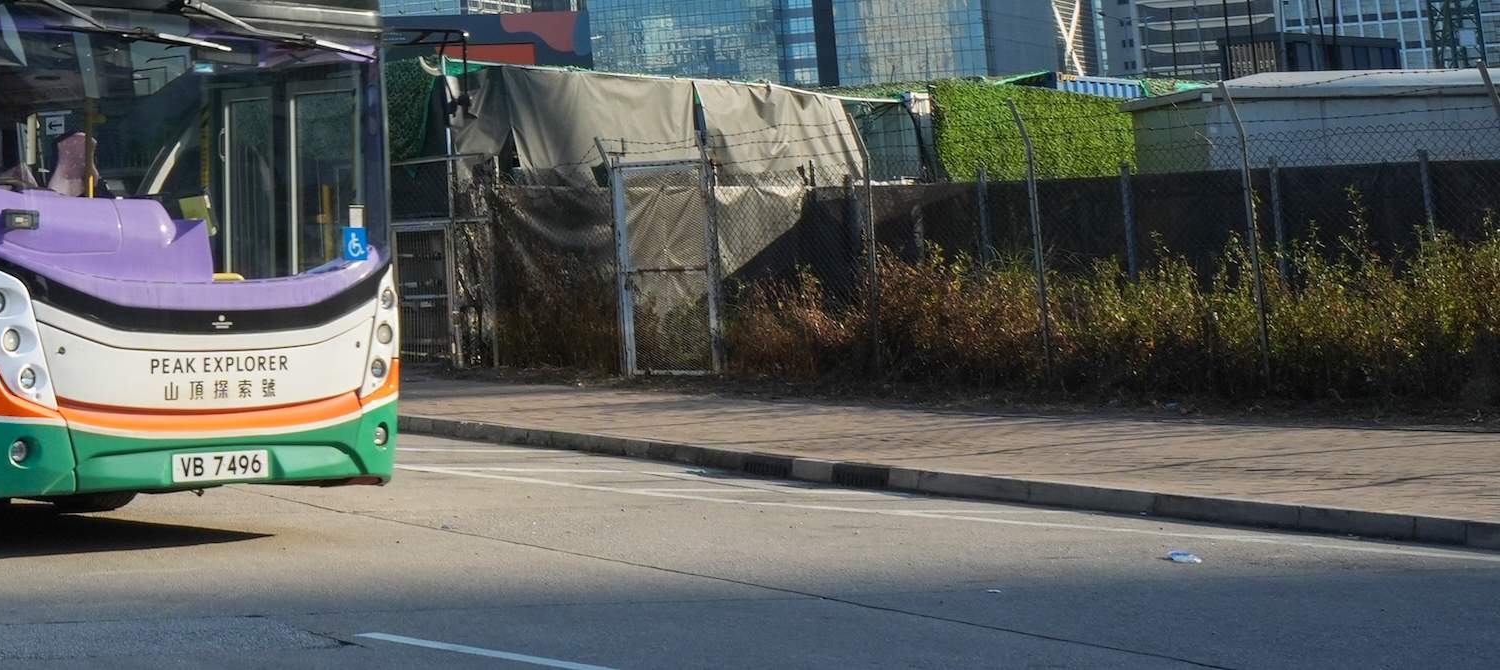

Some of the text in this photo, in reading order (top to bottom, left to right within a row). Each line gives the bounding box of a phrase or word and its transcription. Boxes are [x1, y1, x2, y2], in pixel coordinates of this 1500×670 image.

[150, 355, 289, 374] PEAK EXPLORER
[164, 378, 276, 401] 山頂探索號
[181, 454, 262, 478] VB 7496
